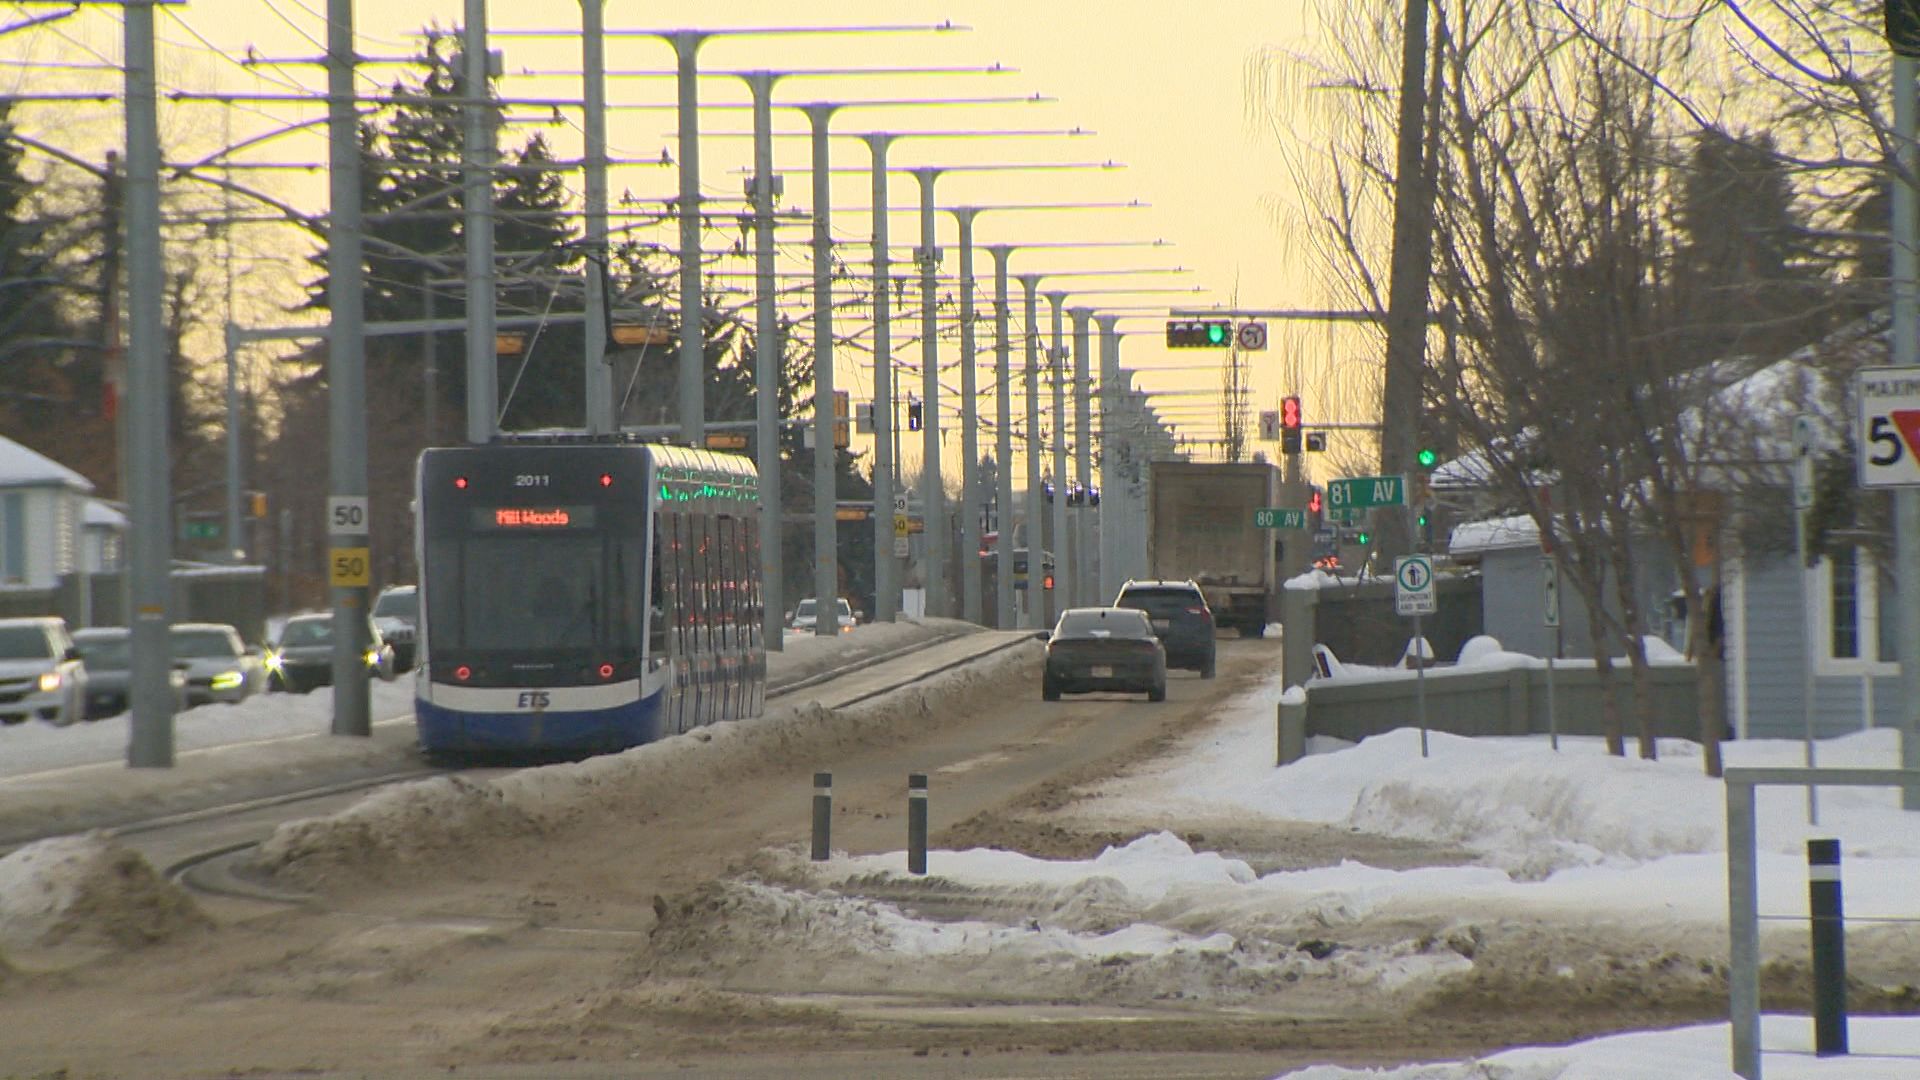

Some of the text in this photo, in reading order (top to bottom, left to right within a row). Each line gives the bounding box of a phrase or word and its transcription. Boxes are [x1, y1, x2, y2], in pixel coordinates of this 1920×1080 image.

[515, 474, 550, 486] 2011
[1332, 481, 1394, 504] 81 AV
[334, 504, 363, 526] 50
[496, 508, 569, 525] Mill Woods
[1257, 511, 1300, 526] 80 AV
[335, 556, 364, 578] 50
[518, 691, 550, 708] ETS
